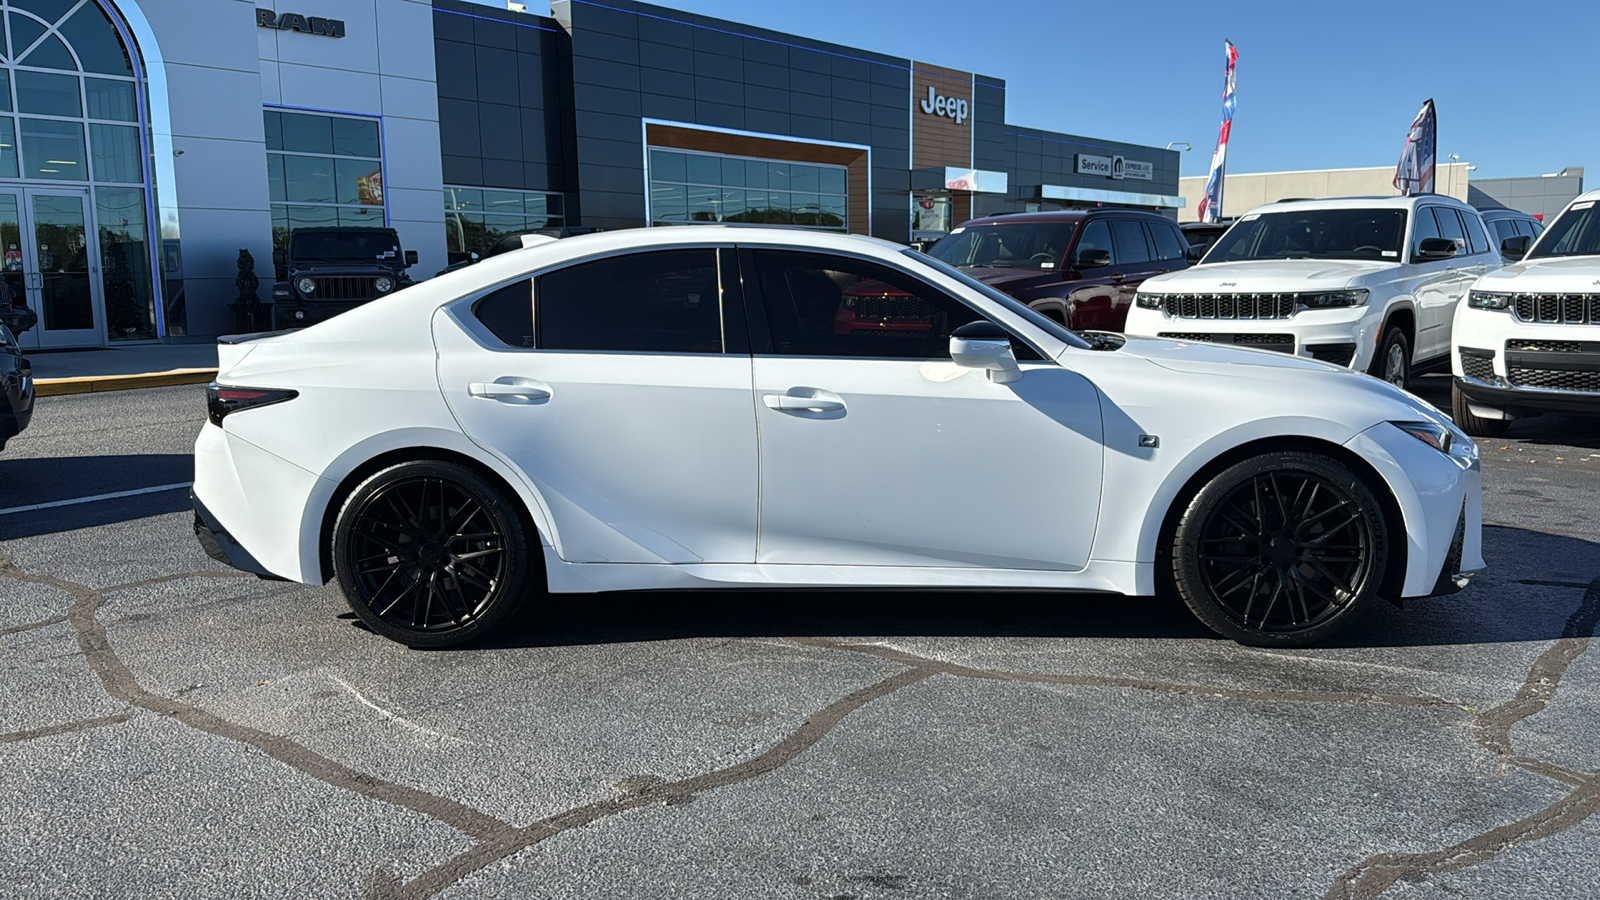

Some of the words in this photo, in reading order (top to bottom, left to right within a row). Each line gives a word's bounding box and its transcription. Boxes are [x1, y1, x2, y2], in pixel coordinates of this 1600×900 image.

[255, 7, 345, 38] RAM
[919, 85, 968, 125] Jeep
[1081, 158, 1109, 172] Service
